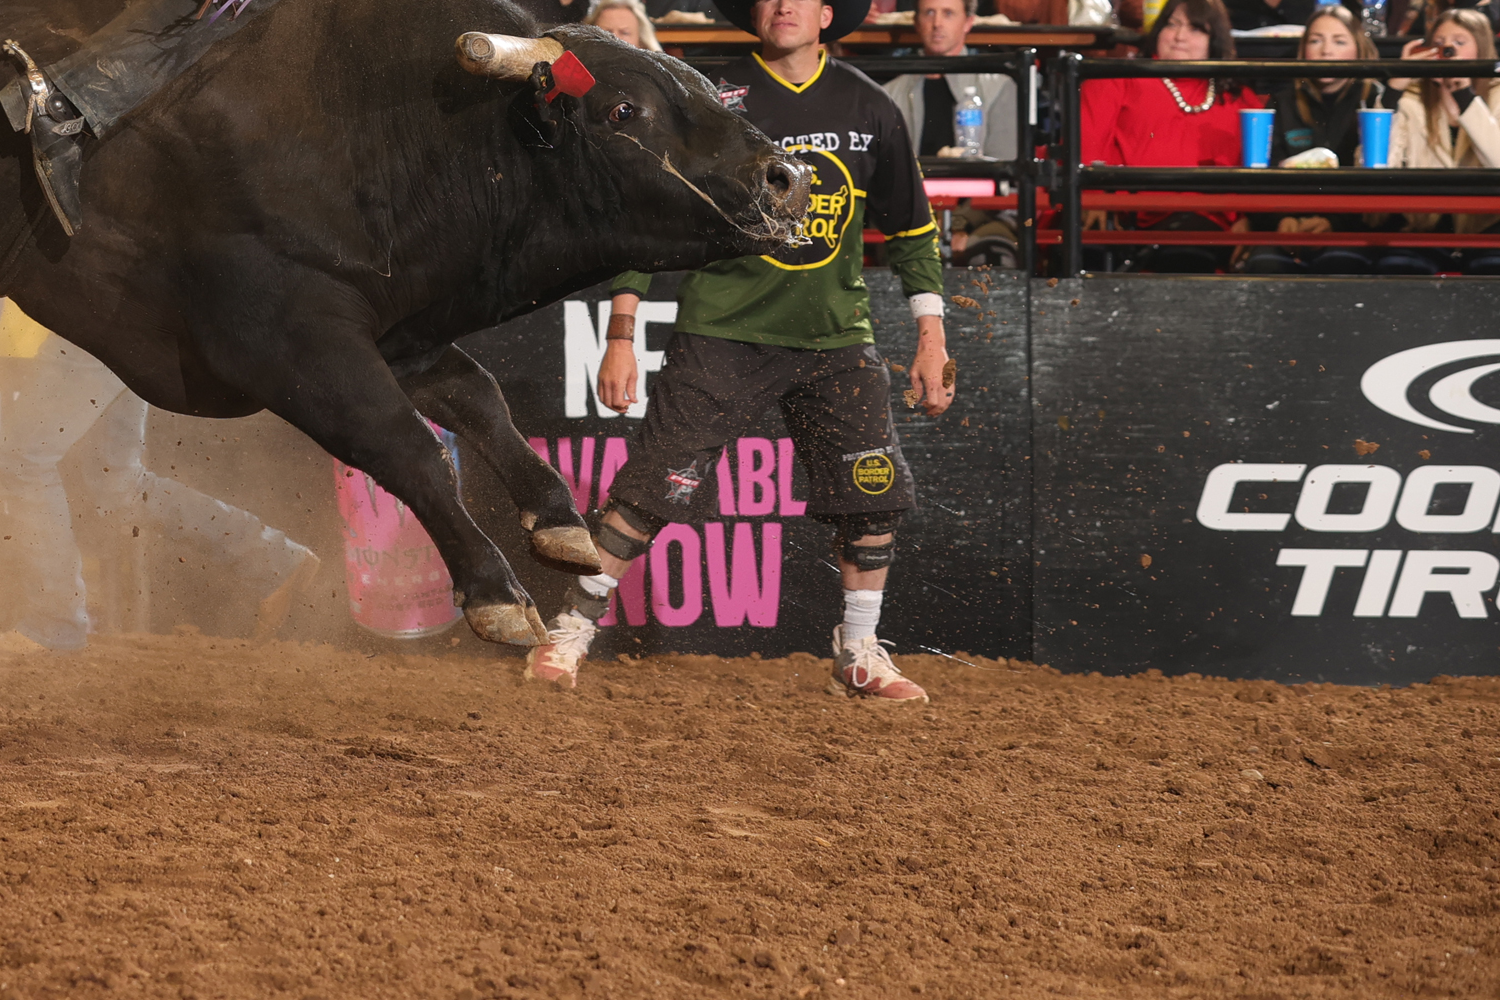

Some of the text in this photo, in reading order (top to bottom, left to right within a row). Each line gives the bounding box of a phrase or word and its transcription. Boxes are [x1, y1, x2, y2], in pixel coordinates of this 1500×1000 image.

[848, 131, 874, 151] BY
[858, 467, 890, 476] BORDER
[1196, 463, 1500, 533] COO
[1276, 548, 1500, 619] TIR
